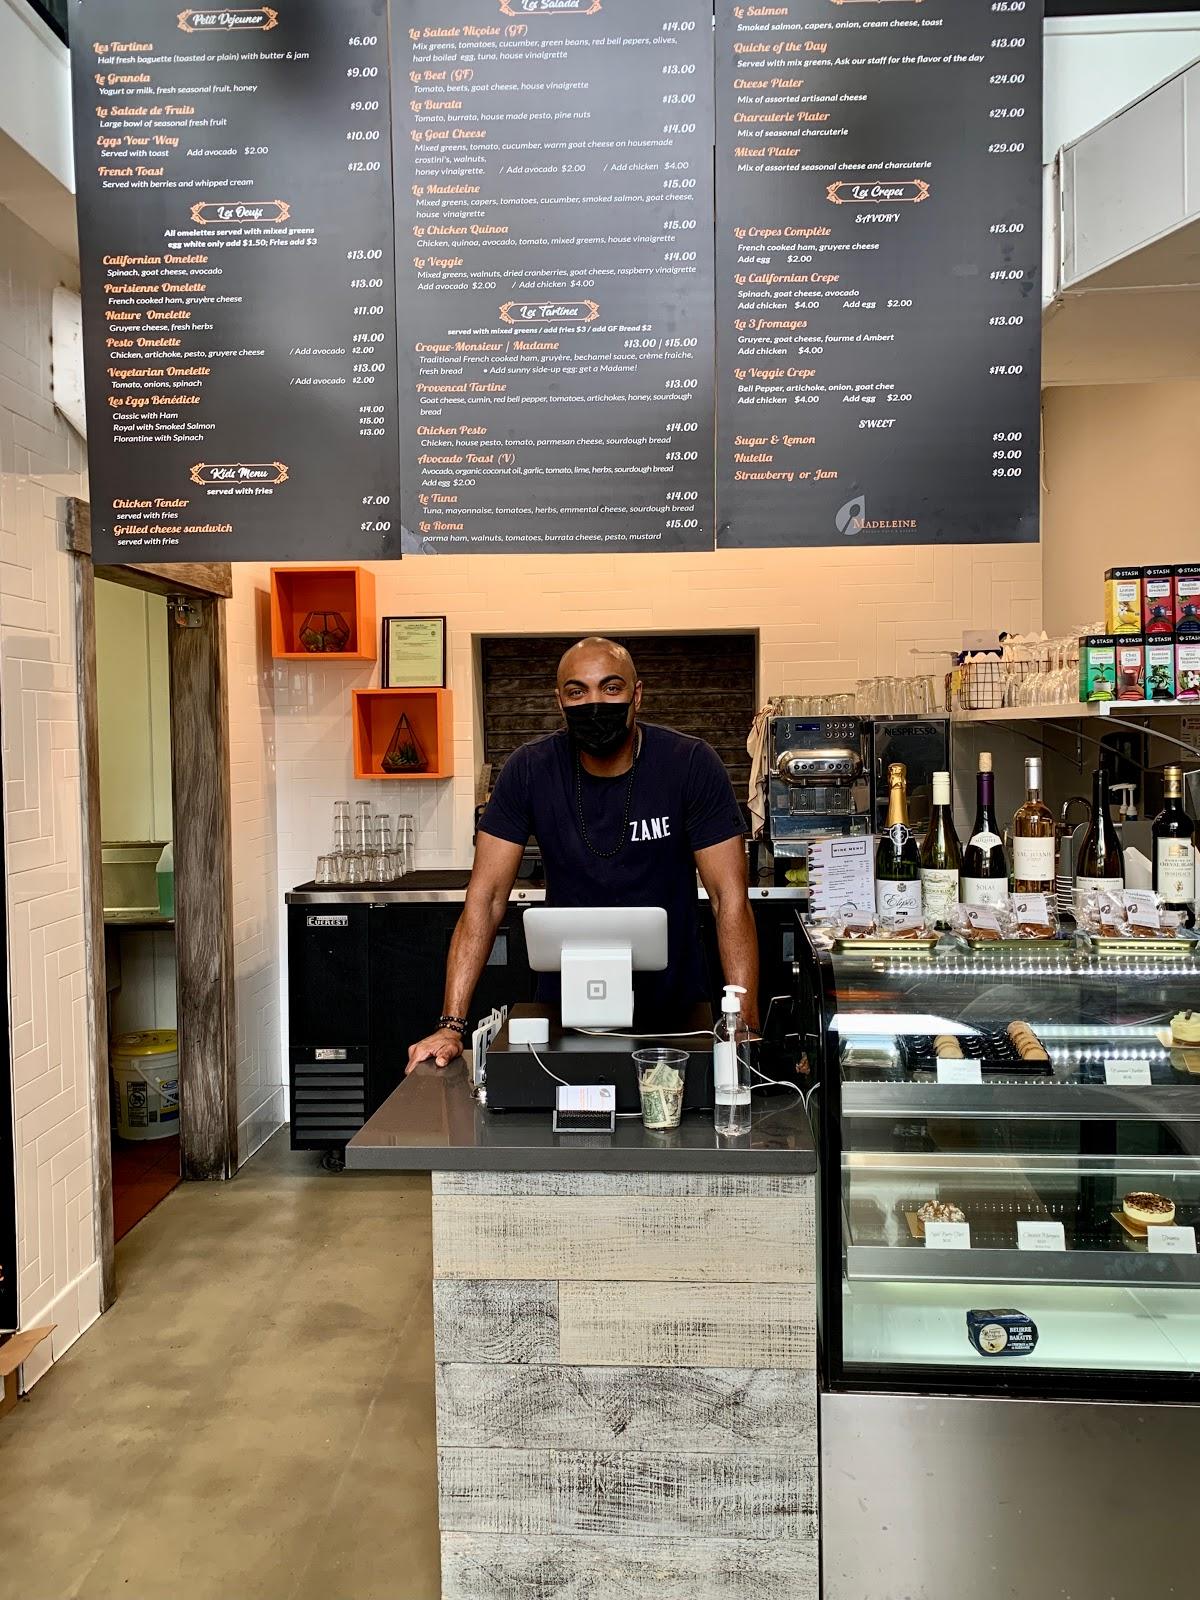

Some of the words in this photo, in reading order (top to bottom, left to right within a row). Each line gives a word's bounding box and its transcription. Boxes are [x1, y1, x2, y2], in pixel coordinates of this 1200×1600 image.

[734, 7, 744, 18] Le
[747, 7, 788, 16] Salmon
[193, 14, 216, 25] Petit
[218, 13, 262, 27] Dejeuner
[663, 22, 695, 31] $14.00
[409, 29, 420, 40] La
[423, 28, 460, 37] Salade
[349, 37, 377, 45] $6.00
[93, 43, 108, 54] Les
[111, 42, 152, 51] Tartines
[734, 43, 770, 53] Quiche
[773, 42, 784, 54] of
[786, 42, 801, 51] the
[804, 41, 827, 53] Day
[116, 56, 135, 64] fresh
[137, 56, 171, 64] baguette
[174, 54, 205, 62] (toasted
[217, 53, 239, 62] plain)
[294, 52, 309, 60] jam
[347, 67, 377, 77] $9.00
[410, 71, 421, 83] La
[424, 71, 446, 80] Beet
[95, 74, 105, 85] Le
[108, 74, 150, 85] Granola
[734, 79, 768, 88] Cheese
[771, 79, 804, 87] Plater
[990, 74, 1024, 83] $24.00
[471, 84, 489, 92] goat
[546, 82, 588, 90] vinaigrette
[801, 94, 838, 102] artisanal
[96, 107, 107, 118] La
[111, 106, 147, 115] Salade
[150, 106, 162, 115] de
[165, 106, 194, 114] Fruits
[97, 136, 121, 147] Eggs
[124, 136, 150, 145] Your
[153, 136, 179, 147] Way
[98, 166, 133, 177] French
[135, 167, 163, 175] Toast
[412, 185, 423, 196] La
[427, 185, 480, 193] Madeleine
[852, 186, 868, 199] Les
[871, 186, 903, 199] Crepes
[217, 207, 233, 219] Les
[855, 214, 900, 223] SAVORY
[413, 226, 424, 237] La
[427, 226, 467, 234] Chicken
[470, 225, 508, 234] Quinoa
[734, 228, 746, 239] La
[749, 227, 781, 238] Crepes
[784, 227, 831, 238] Complète
[347, 250, 382, 259] $13.00
[103, 255, 161, 267] Californian
[164, 255, 208, 263] Omelette
[414, 257, 425, 269] La
[428, 257, 463, 268] Veggie
[734, 274, 746, 285] La
[749, 274, 808, 285] Californian
[811, 273, 839, 284] Crepe
[520, 306, 536, 319] Les
[539, 305, 578, 317] Tartines
[734, 319, 746, 330] La
[749, 319, 755, 328] 3
[756, 319, 807, 330] fromages
[106, 338, 133, 347] Pesto
[137, 338, 181, 346] Omelette
[107, 368, 164, 379] Vegetarian
[166, 367, 210, 375] Omelette
[108, 397, 123, 407] Les
[125, 396, 149, 407] Eggs
[666, 423, 698, 431] $14.00
[858, 419, 894, 429] SWEET
[417, 426, 457, 435] Chicken
[460, 426, 487, 434] Pesto
[607, 437, 647, 445] sourdough
[735, 436, 768, 447] Sugar
[771, 435, 779, 444] &
[783, 435, 815, 446] Lemon
[993, 432, 1022, 441] $9.00
[418, 454, 463, 464] Avocado
[466, 454, 493, 463] Toast
[498, 454, 515, 465] (V)
[734, 453, 772, 462] Nutella
[210, 468, 235, 479] Kids
[238, 467, 268, 479] Menu
[735, 471, 794, 481] Strawberry
[814, 470, 837, 480] Jam
[113, 499, 152, 508] Chicken
[154, 499, 189, 507] Tender
[363, 496, 389, 504] $7.00
[419, 494, 429, 505] Le
[431, 494, 457, 502] Tuna
[419, 521, 430, 532] La
[433, 521, 463, 530] Roma
[666, 519, 698, 528] $15.00
[114, 525, 148, 536] Grilled
[150, 525, 181, 533] cheese
[183, 524, 232, 532] sandwich
[884, 727, 937, 736] NESPRESSO
